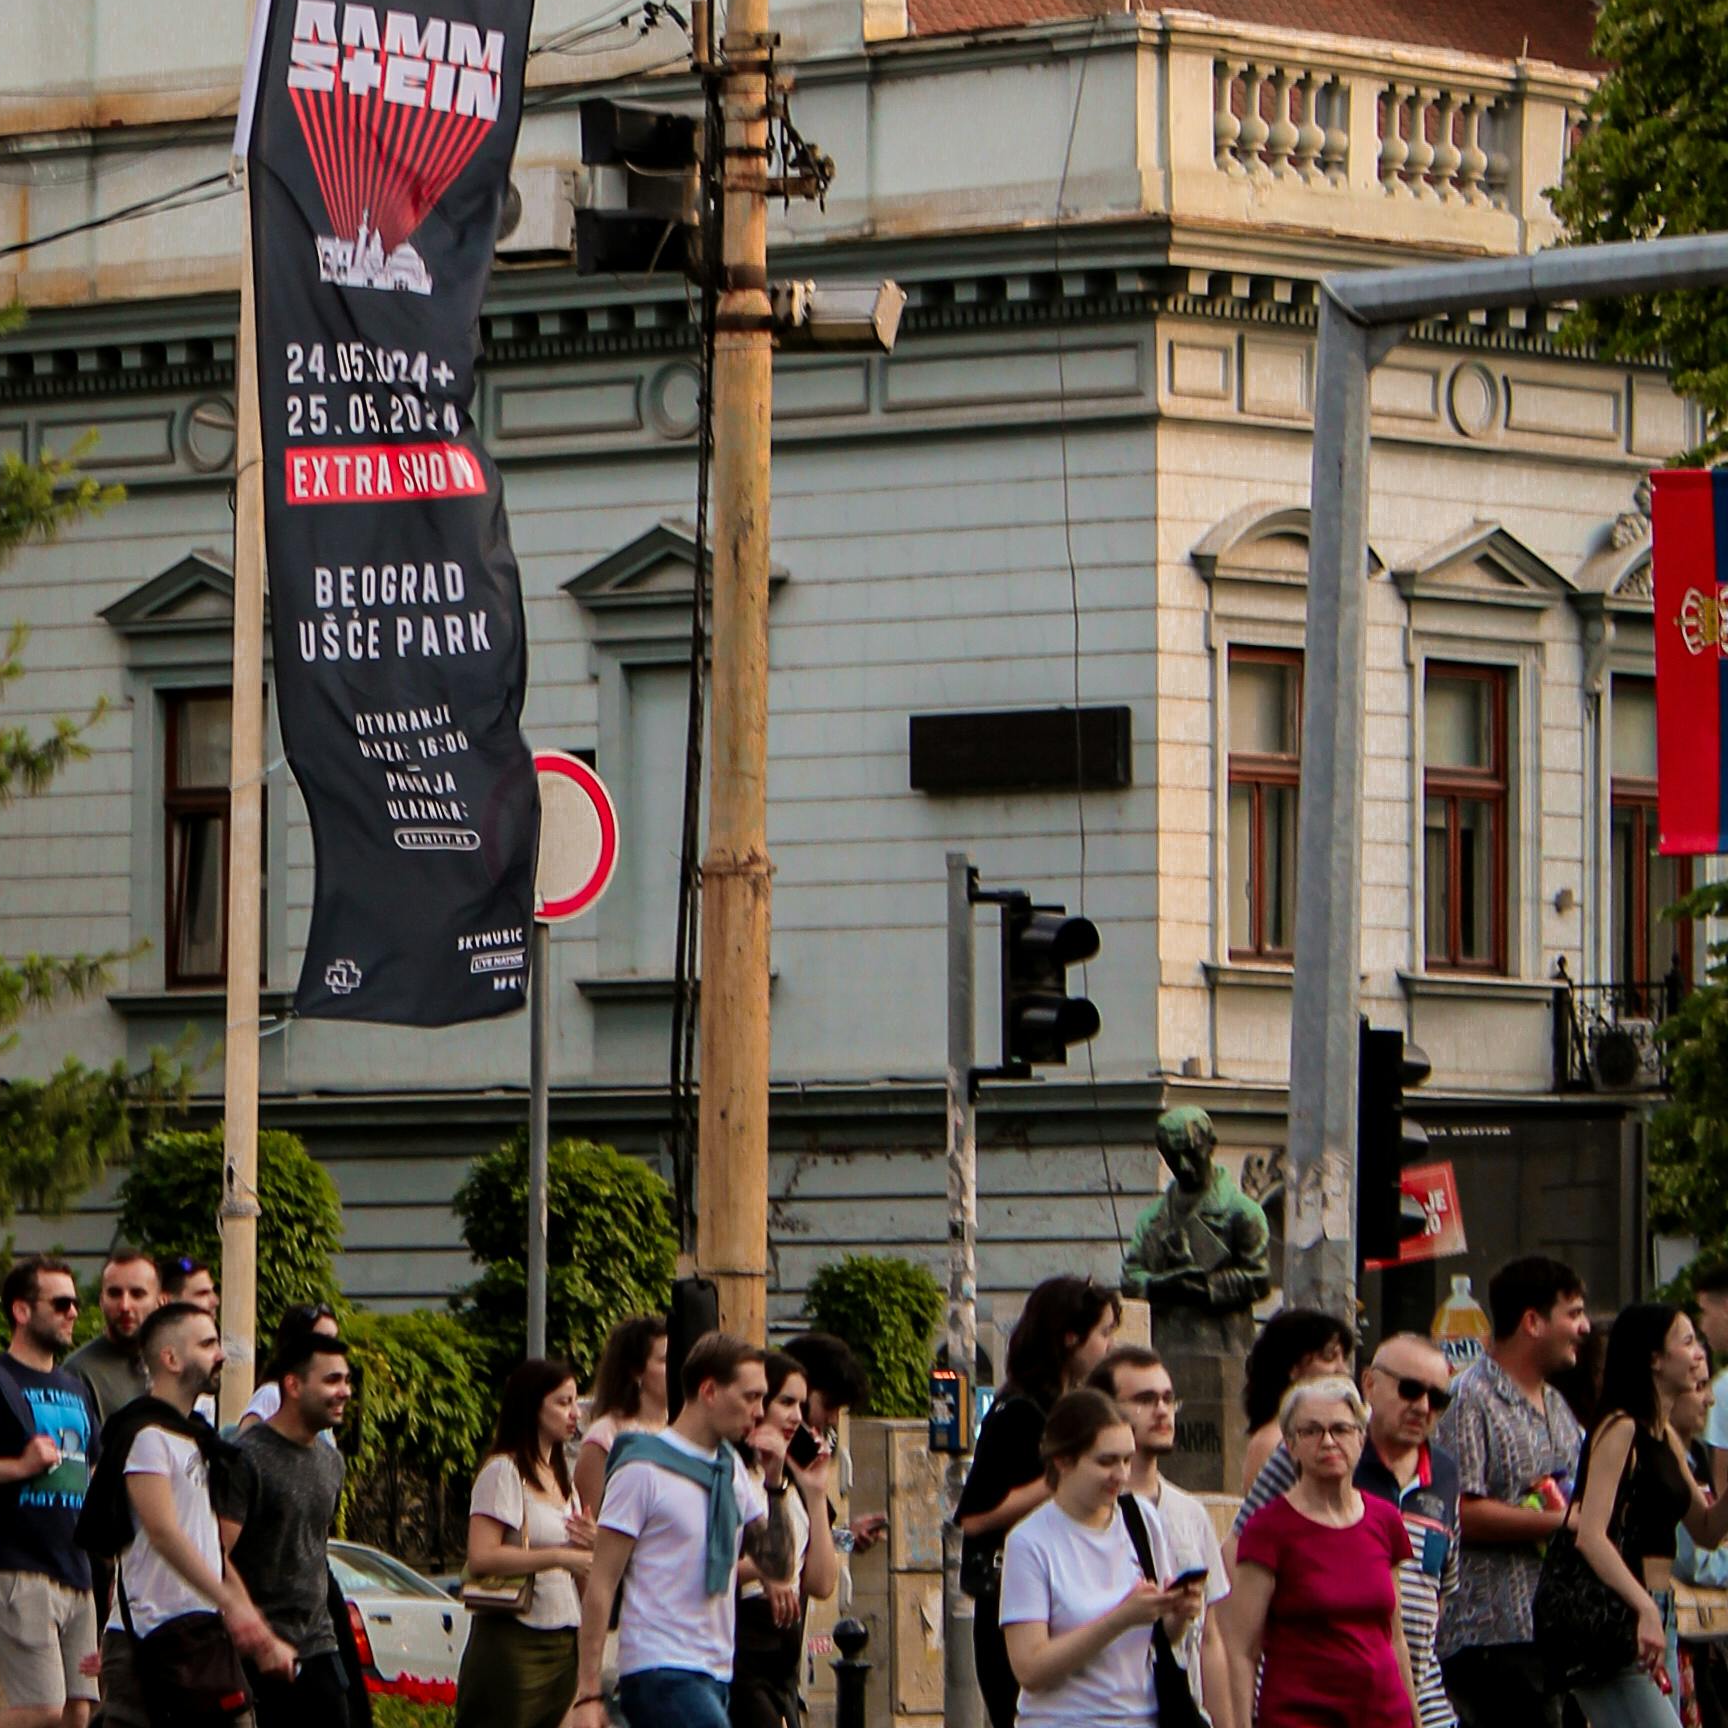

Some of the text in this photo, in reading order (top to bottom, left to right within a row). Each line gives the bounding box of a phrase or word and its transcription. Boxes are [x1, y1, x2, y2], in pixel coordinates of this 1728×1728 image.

[293, 448, 476, 498] EXTRA SHOW
[314, 561, 465, 609] BEOGRAD
[396, 609, 492, 658] PARK
[417, 730, 470, 759] 16:00
[457, 927, 524, 951] SKYMUSIC
